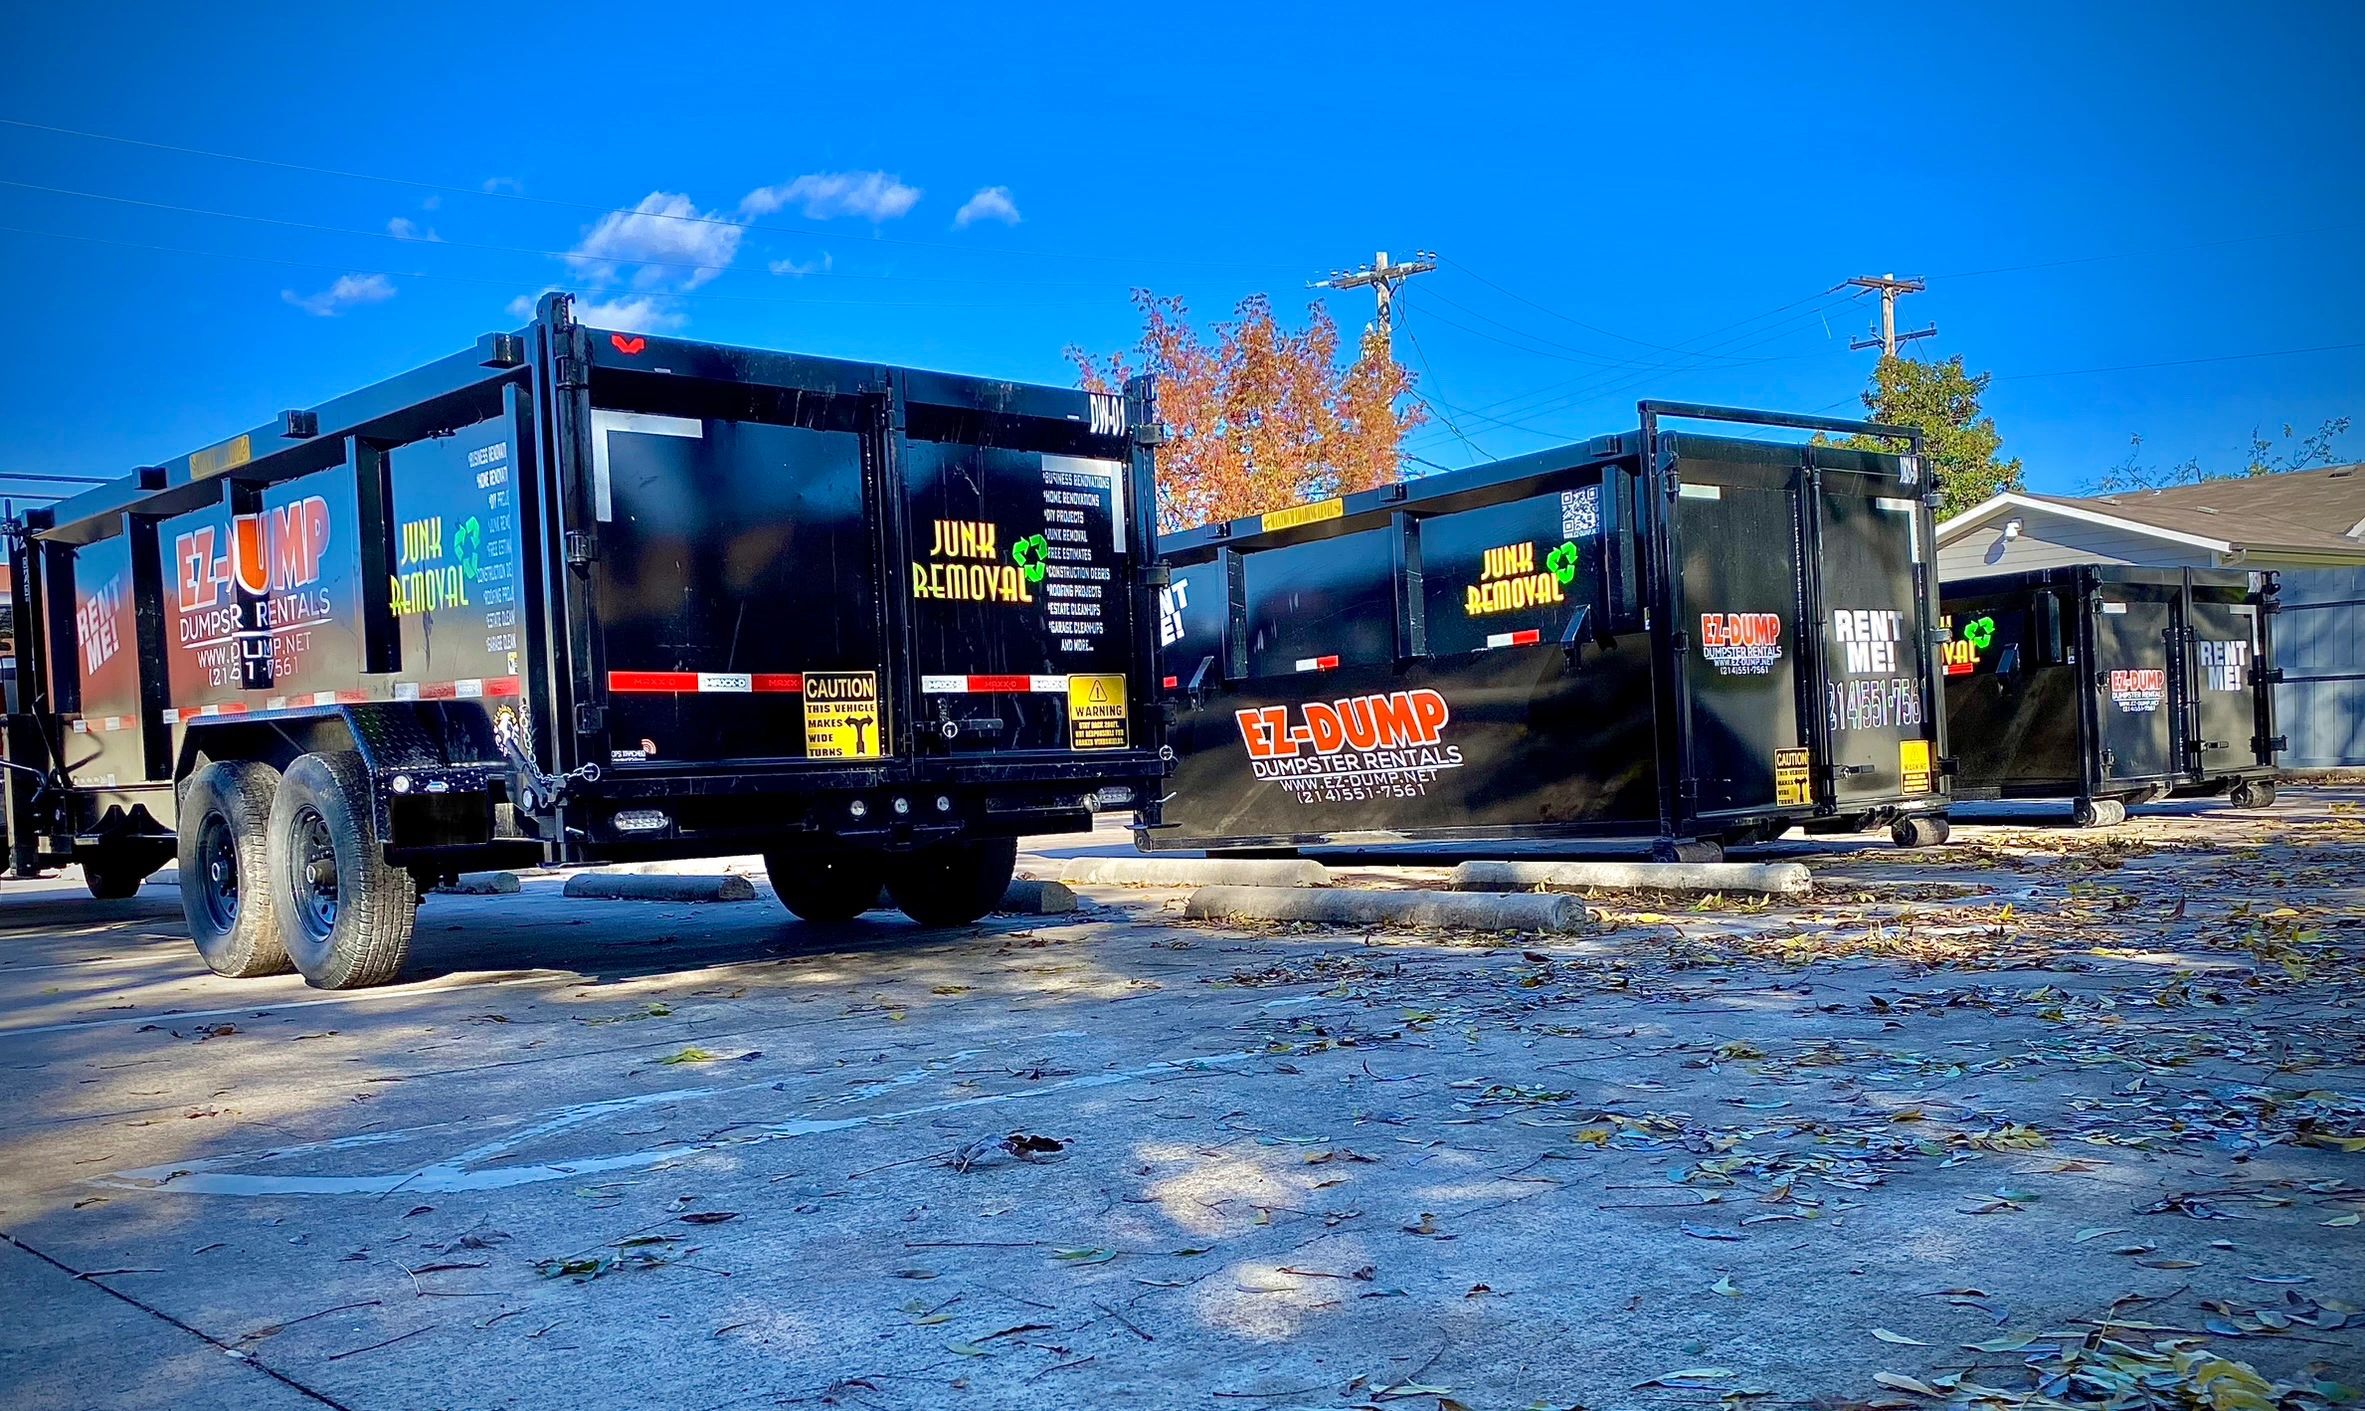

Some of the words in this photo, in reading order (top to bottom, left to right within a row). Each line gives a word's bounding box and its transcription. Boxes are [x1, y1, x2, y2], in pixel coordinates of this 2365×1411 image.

[1090, 394, 1125, 436] DW-01
[1073, 474, 1110, 489] RENOVATIONS
[1063, 491, 1099, 507] RENOVATIONS
[1056, 509, 1084, 524] PROJECTS
[401, 516, 442, 565] JUNK
[930, 519, 996, 559] JUNK
[1063, 529, 1088, 542] REMOVAL
[1063, 548, 1091, 561] ESTIMATES
[1481, 541, 1534, 581] JUNK
[912, 561, 1033, 602] REMOVAL
[1091, 567, 1110, 580] DEBRIS
[389, 565, 469, 617] REMOVAL
[1074, 585, 1102, 598] PROJECTS
[1159, 578, 1189, 620] NT
[1464, 572, 1564, 615] REMOVAL
[76, 573, 120, 648] RENT
[1160, 610, 1185, 647] E!
[1701, 613, 1781, 647] EZ-DUMP
[1833, 609, 1904, 642] RENT
[85, 615, 120, 675] ME!
[1703, 647, 1746, 658] DUMPSTER
[1747, 646, 1782, 657] RENTALS
[1846, 641, 1896, 673] ME!
[2200, 641, 2247, 666] RENT
[806, 678, 874, 698] CAUTION
[2111, 670, 2164, 692] EZ-DUMP
[2208, 666, 2242, 691] ME!
[807, 704, 831, 713] THIS
[834, 703, 875, 713] VEHICLE
[1075, 705, 1122, 717] WARNING
[808, 719, 843, 728] MAKES
[1235, 688, 1450, 760] EZ-DUMP
[808, 733, 834, 742] WIDE
[809, 748, 843, 757] TURNS
[1251, 752, 1361, 778] DUMPSTER
[1364, 745, 1463, 769] RENTALS
[1777, 752, 1808, 767] CAUTION
[1279, 768, 1438, 792] WWW.EZ-DUMP.NET
[1297, 783, 1426, 804] (214)551-7561
